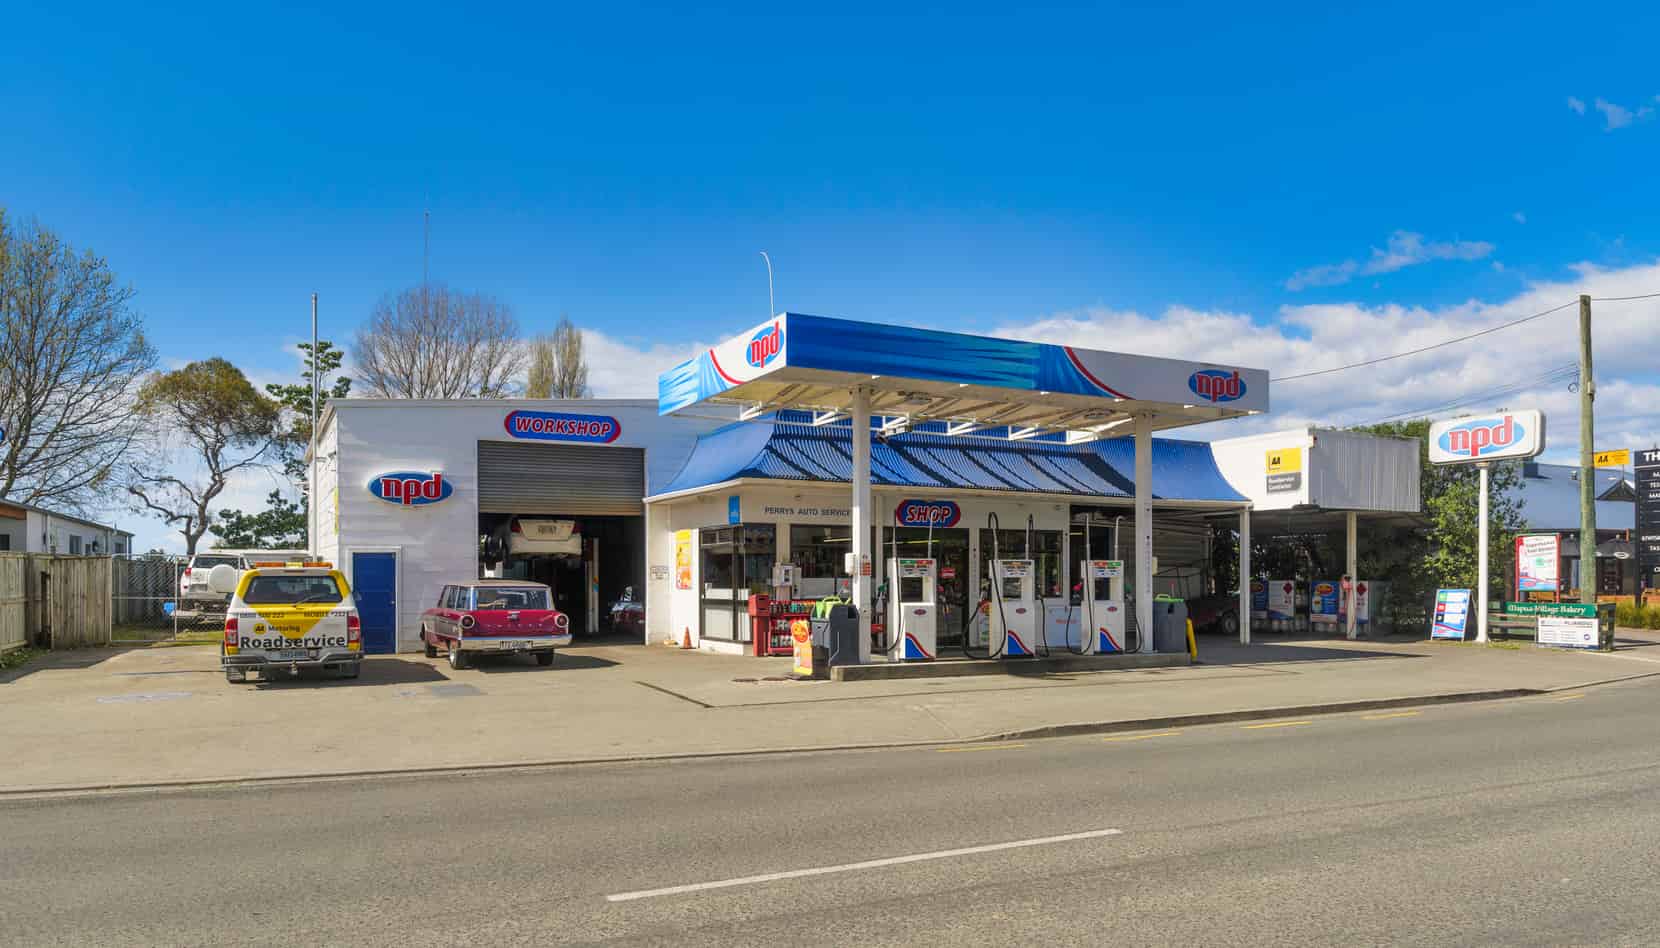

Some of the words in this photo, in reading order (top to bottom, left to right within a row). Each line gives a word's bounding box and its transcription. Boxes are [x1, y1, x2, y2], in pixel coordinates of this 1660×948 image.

[751, 320, 779, 368] npd
[1196, 369, 1239, 402] npd
[515, 416, 612, 437] WORKSHOP
[1449, 415, 1513, 457] npd
[380, 473, 443, 504] npd
[797, 507, 819, 516] AUTO
[906, 505, 952, 522] SHOP
[1560, 605, 1586, 616] Bakery
[268, 624, 300, 632] Motoring
[240, 634, 346, 648] Roadservice
